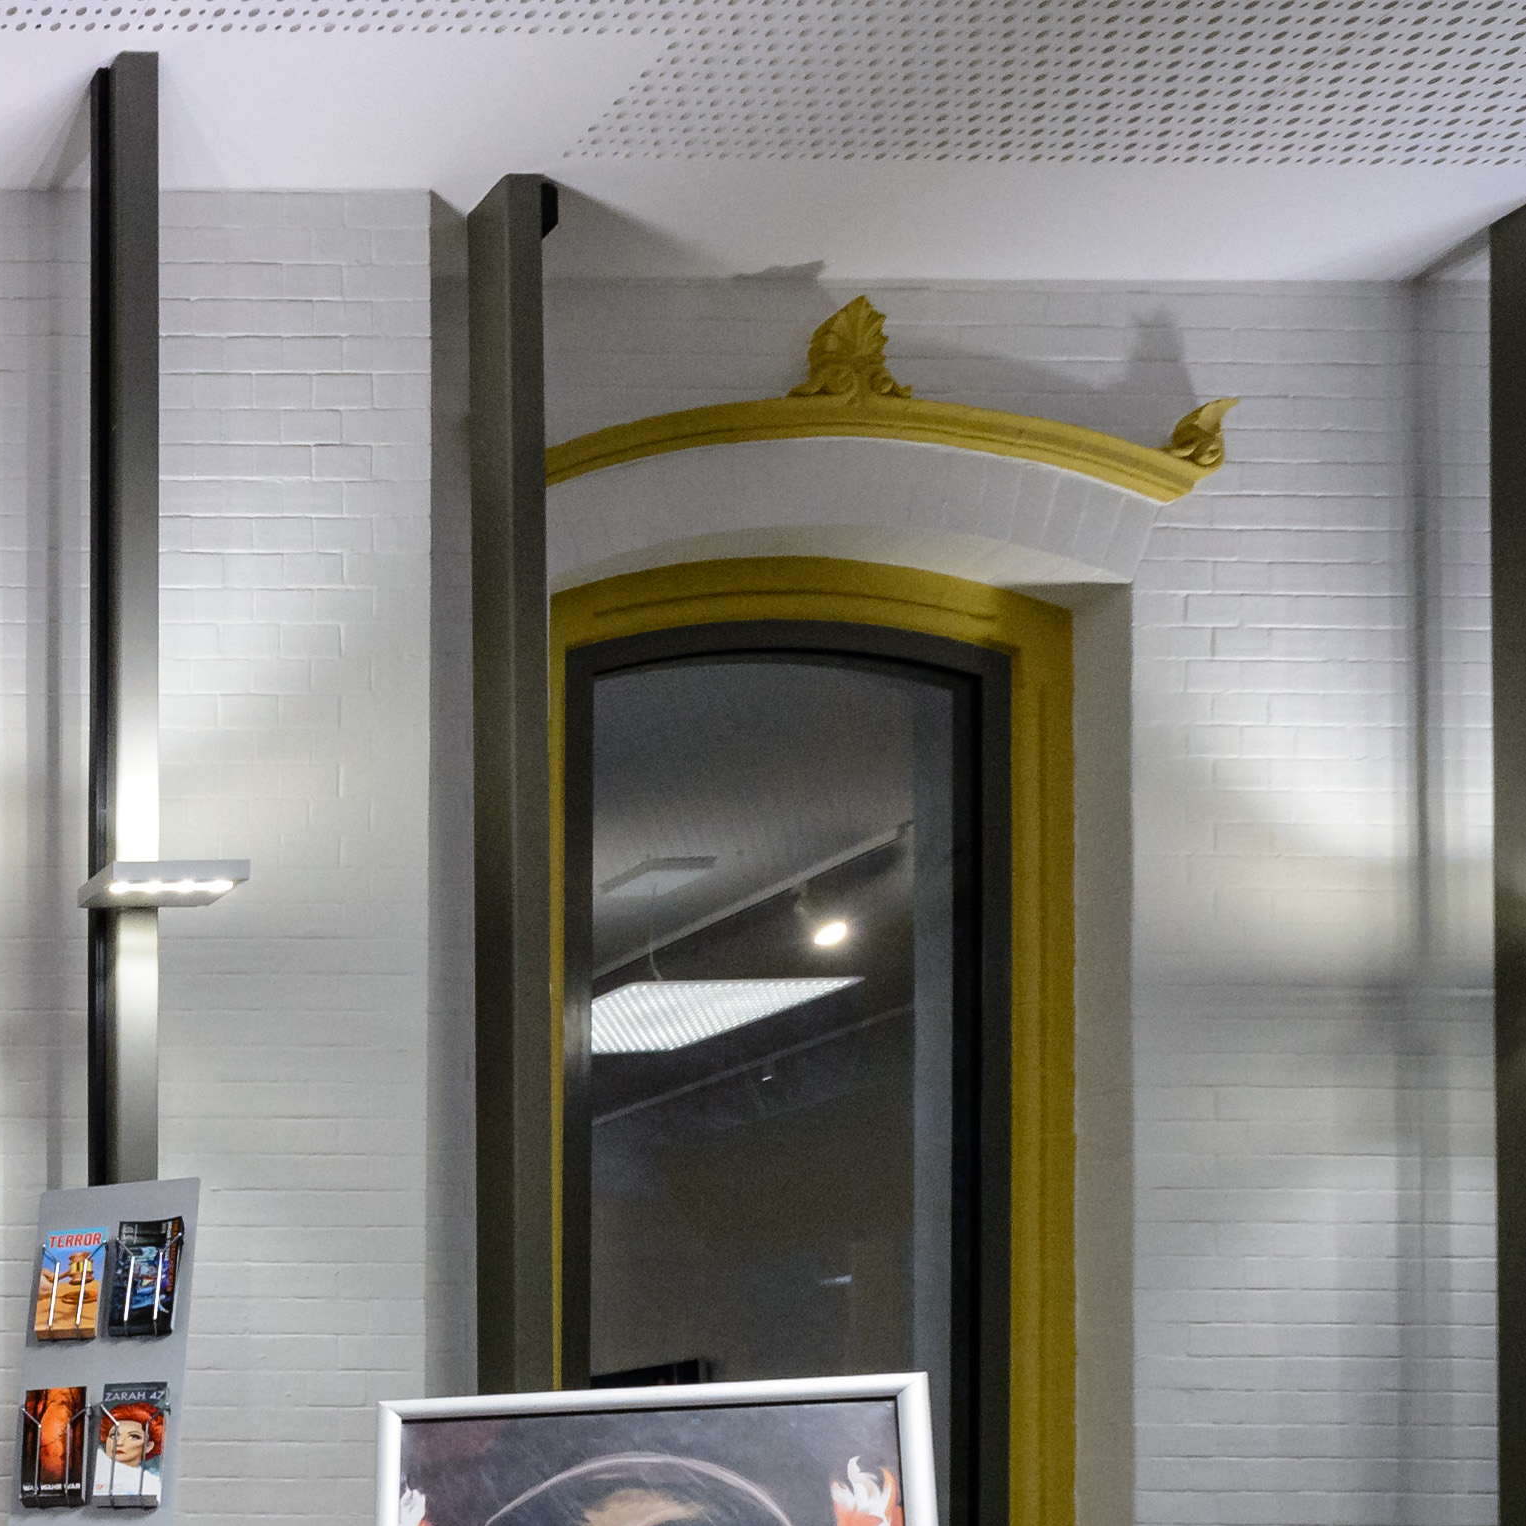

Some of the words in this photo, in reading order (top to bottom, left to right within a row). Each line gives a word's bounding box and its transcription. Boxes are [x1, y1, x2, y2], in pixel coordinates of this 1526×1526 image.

[50, 1232, 102, 1248] TERROR
[104, 1391, 146, 1402] ZARAH
[149, 1391, 165, 1400] 47
